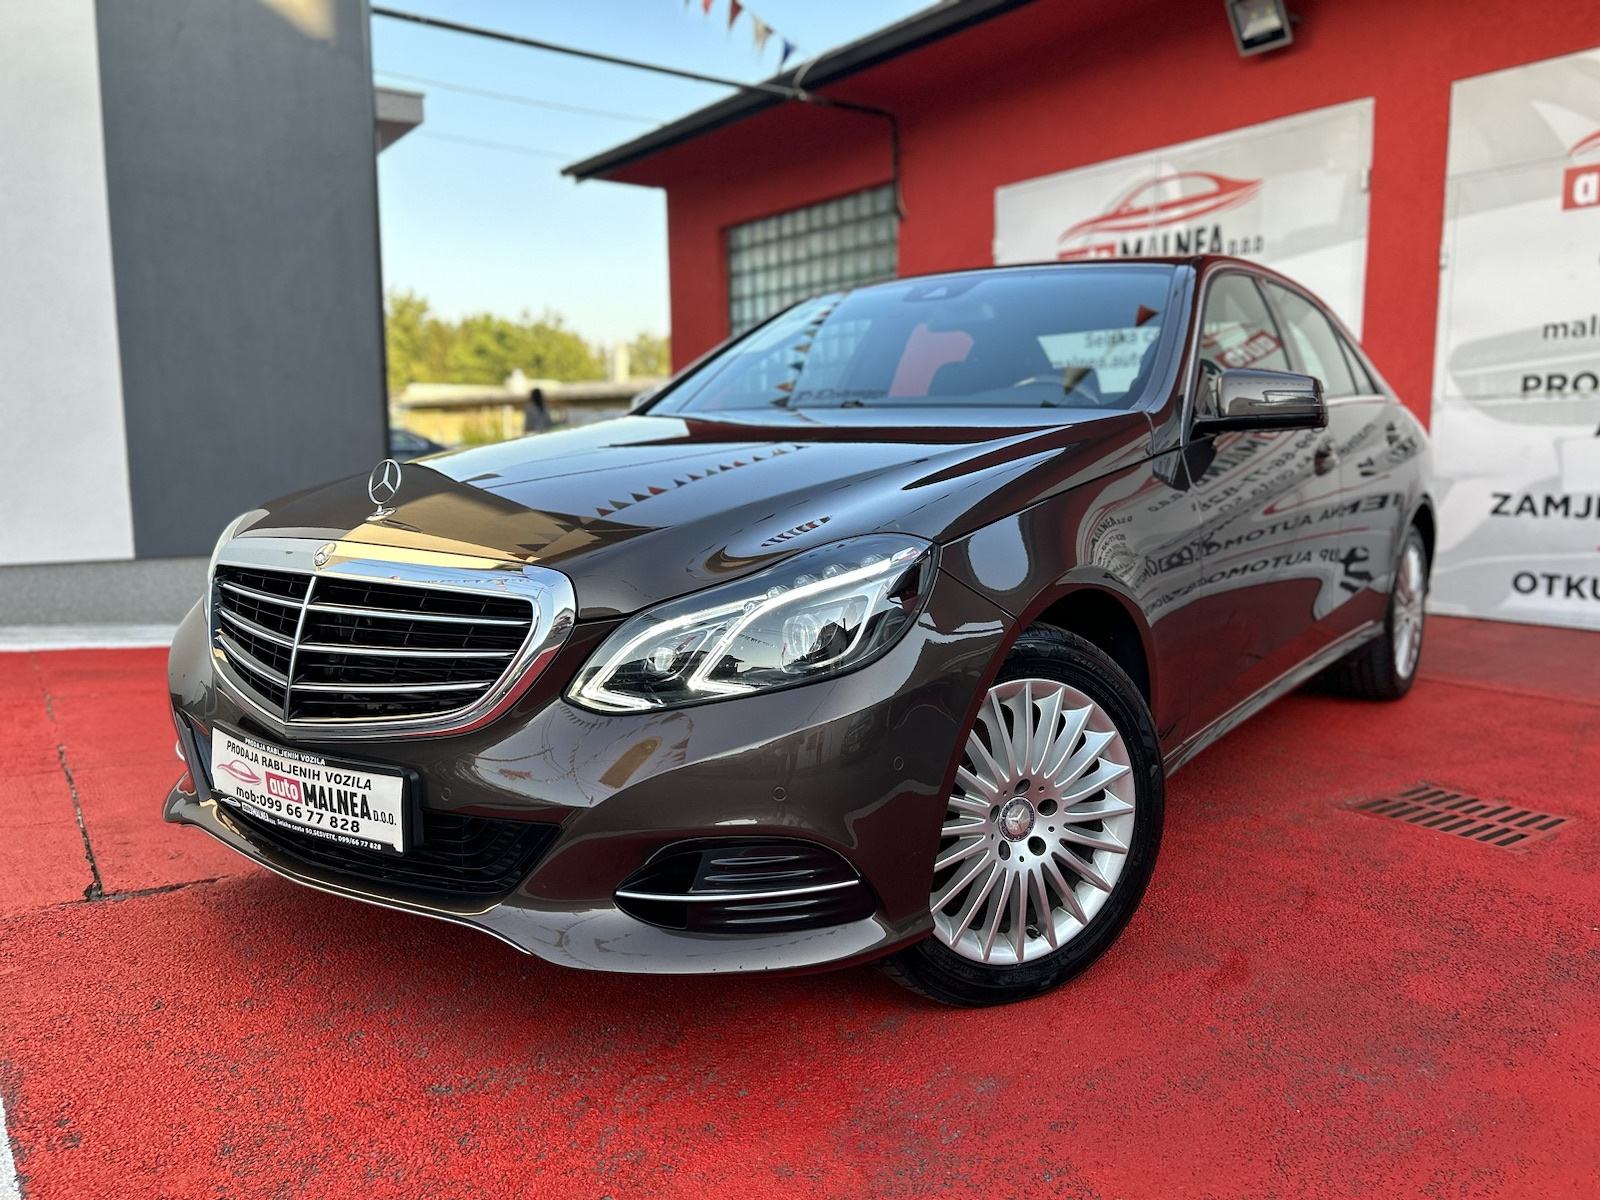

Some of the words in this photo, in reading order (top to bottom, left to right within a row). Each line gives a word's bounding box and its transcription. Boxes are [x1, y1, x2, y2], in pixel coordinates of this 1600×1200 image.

[1121, 224, 1224, 256] MALNEA
[1542, 314, 1600, 339] mal
[1490, 492, 1600, 520] ZAMJ
[226, 740, 260, 765] PRODAJA
[261, 756, 321, 781] RABLJENIH
[325, 771, 372, 791] VOZILA
[244, 737, 267, 752] PRODAJA
[266, 745, 300, 761] RABLJENIH
[300, 754, 326, 767] VOZILA
[236, 786, 282, 812] mob:099
[286, 804, 302, 819] 66
[306, 809, 324, 824] 77
[329, 816, 360, 833] 828
[269, 777, 299, 801] auto
[302, 781, 372, 821] MALNEA
[360, 840, 369, 848] 77
